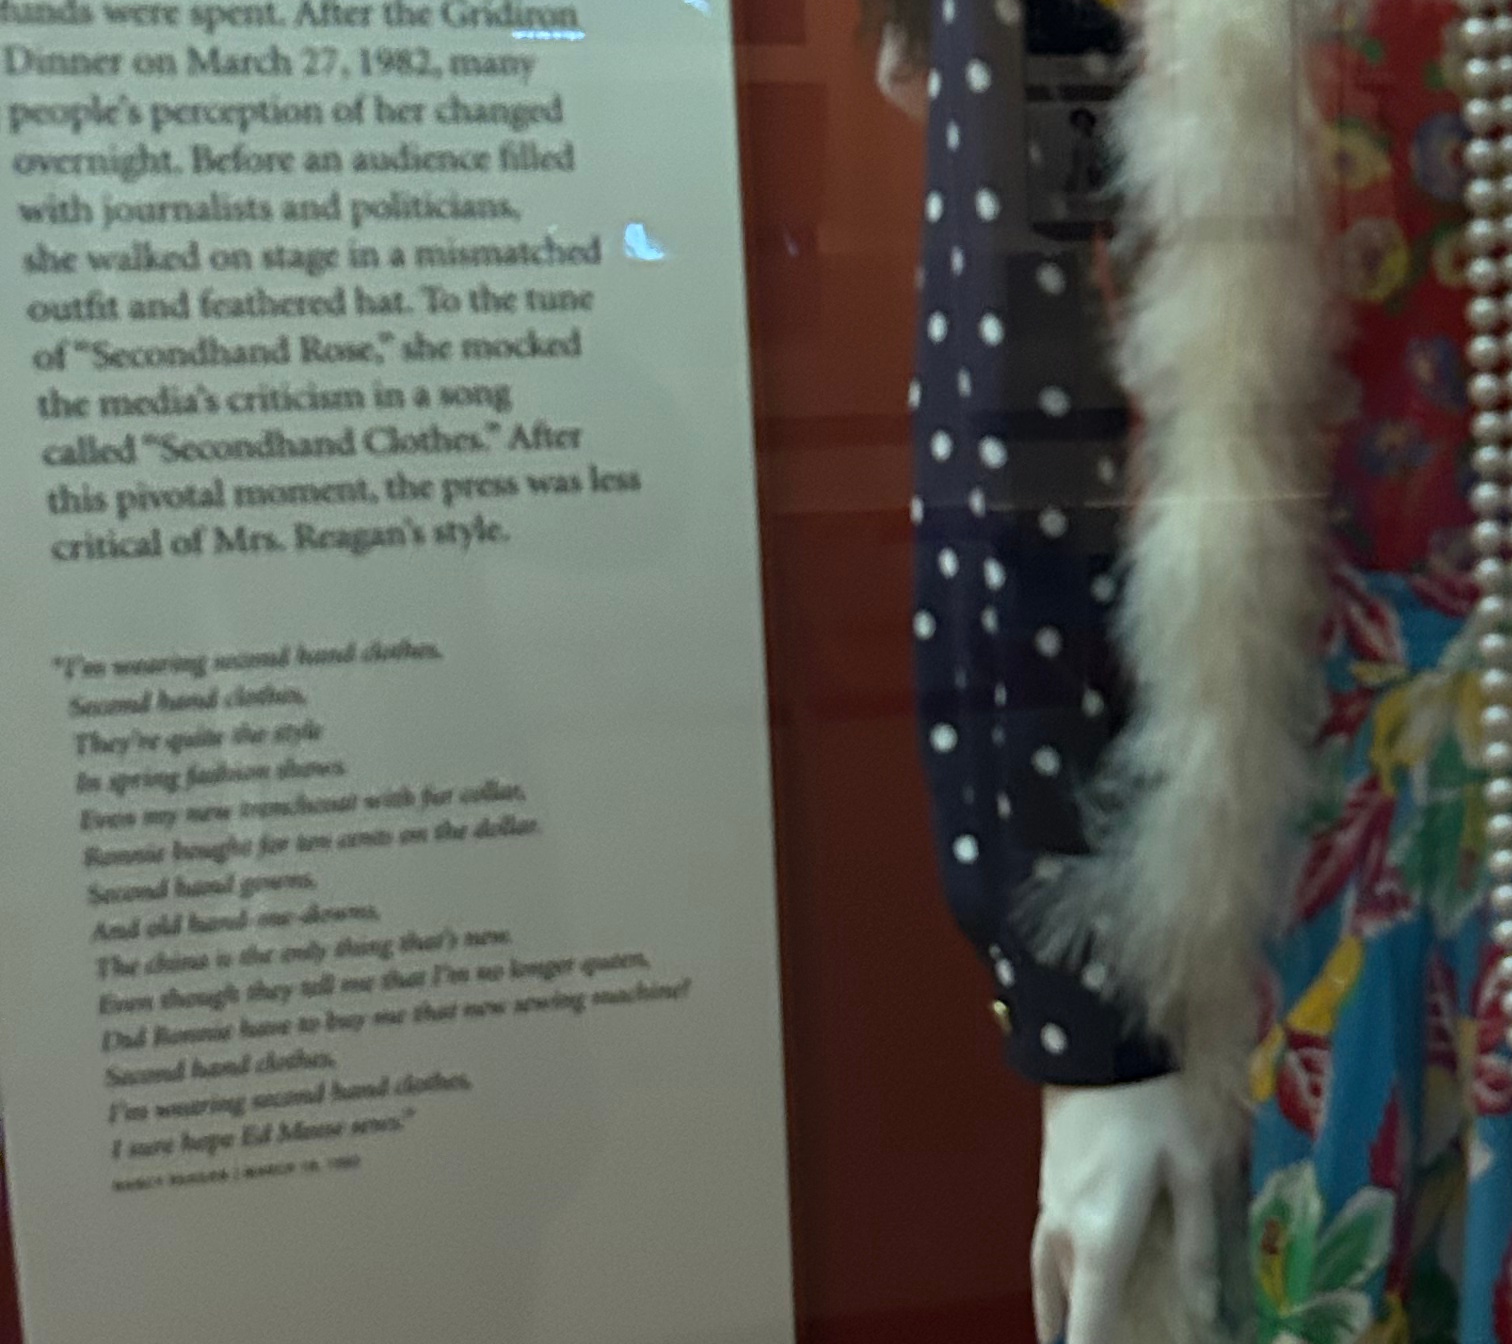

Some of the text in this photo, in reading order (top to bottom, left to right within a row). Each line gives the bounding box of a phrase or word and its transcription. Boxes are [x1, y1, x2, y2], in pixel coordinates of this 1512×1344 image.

[103, 2, 179, 27] were
[189, 1, 287, 36] spent.
[4, 44, 536, 86] Dinner on March 27, 1982, many
[9, 91, 563, 135] people's perception of her changed
[12, 138, 575, 184] overnight. Before an audience filled
[18, 188, 522, 231] with journalists and politicians,
[24, 234, 601, 277] she walked on stage in a mismatched
[26, 280, 594, 323] outfit and feathered hat. To the tune
[32, 337, 72, 372] of
[402, 330, 452, 364] she
[461, 325, 582, 362] mocked
[37, 377, 513, 419] the media's criticism in a song
[42, 432, 137, 467] called
[508, 417, 583, 452] After
[47, 461, 643, 521] this pivotal moment, the press was less
[51, 512, 512, 562] critical of Mrs. Reagan's style.
[69, 685, 219, 718] Second hand
